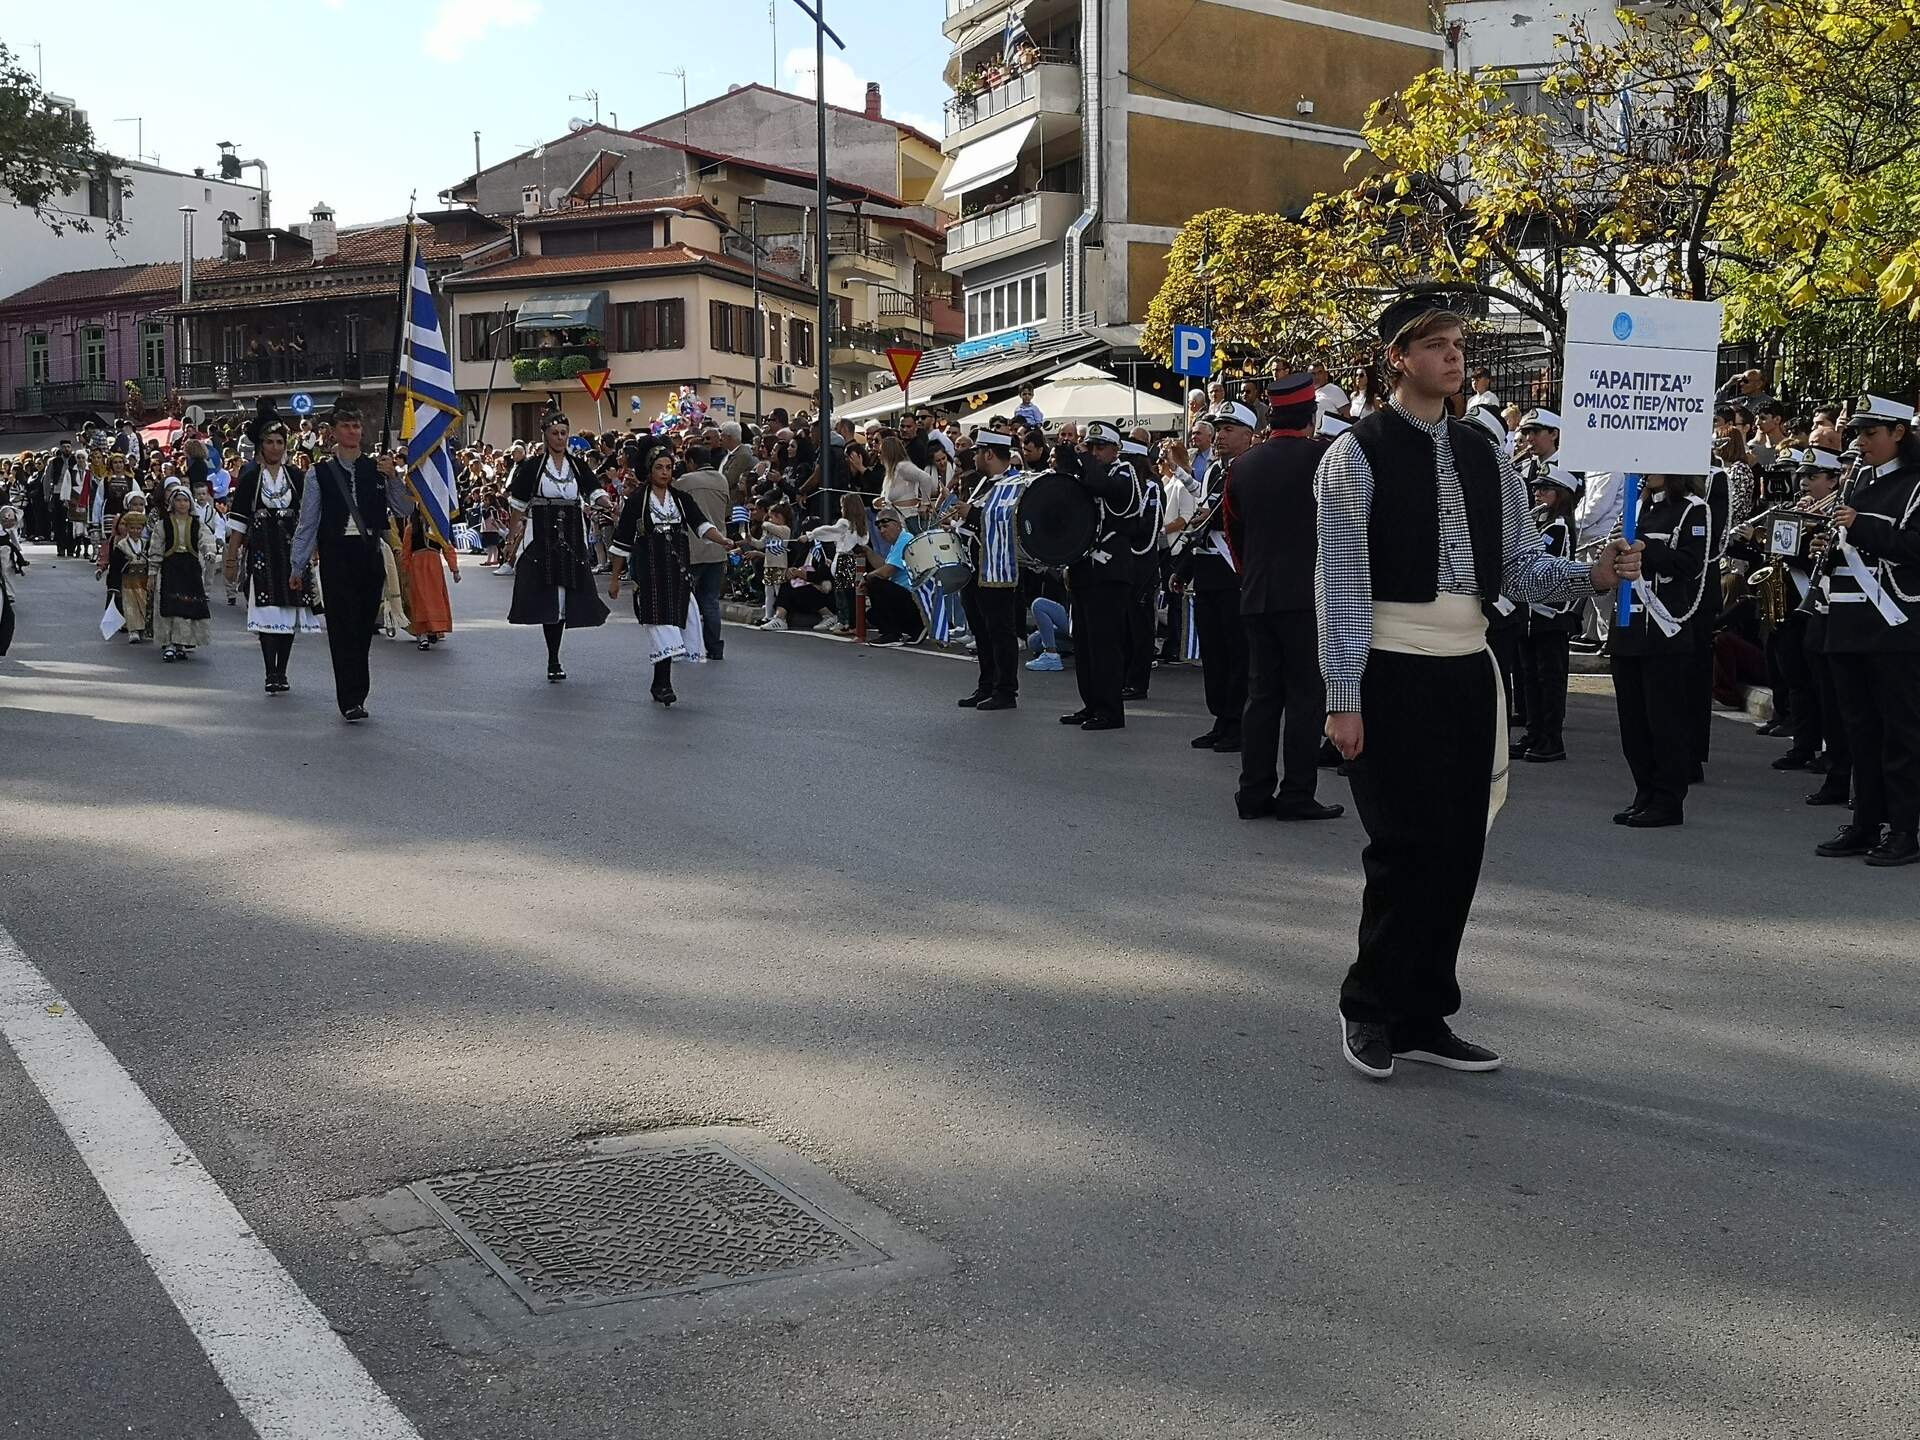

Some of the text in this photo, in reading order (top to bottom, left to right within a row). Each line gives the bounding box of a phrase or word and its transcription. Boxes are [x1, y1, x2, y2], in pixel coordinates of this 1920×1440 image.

[1181, 331, 1205, 369] P
[1589, 370, 1691, 392] “ΑΡΑΠΙΤΣΑ”
[1573, 393, 1704, 413] ΟΜΙΛΟΣ ΠΕΡ/ΝΤΟΣ
[1587, 413, 1688, 432] & ΠΟΛΙΤΙΣΜΟΥ
